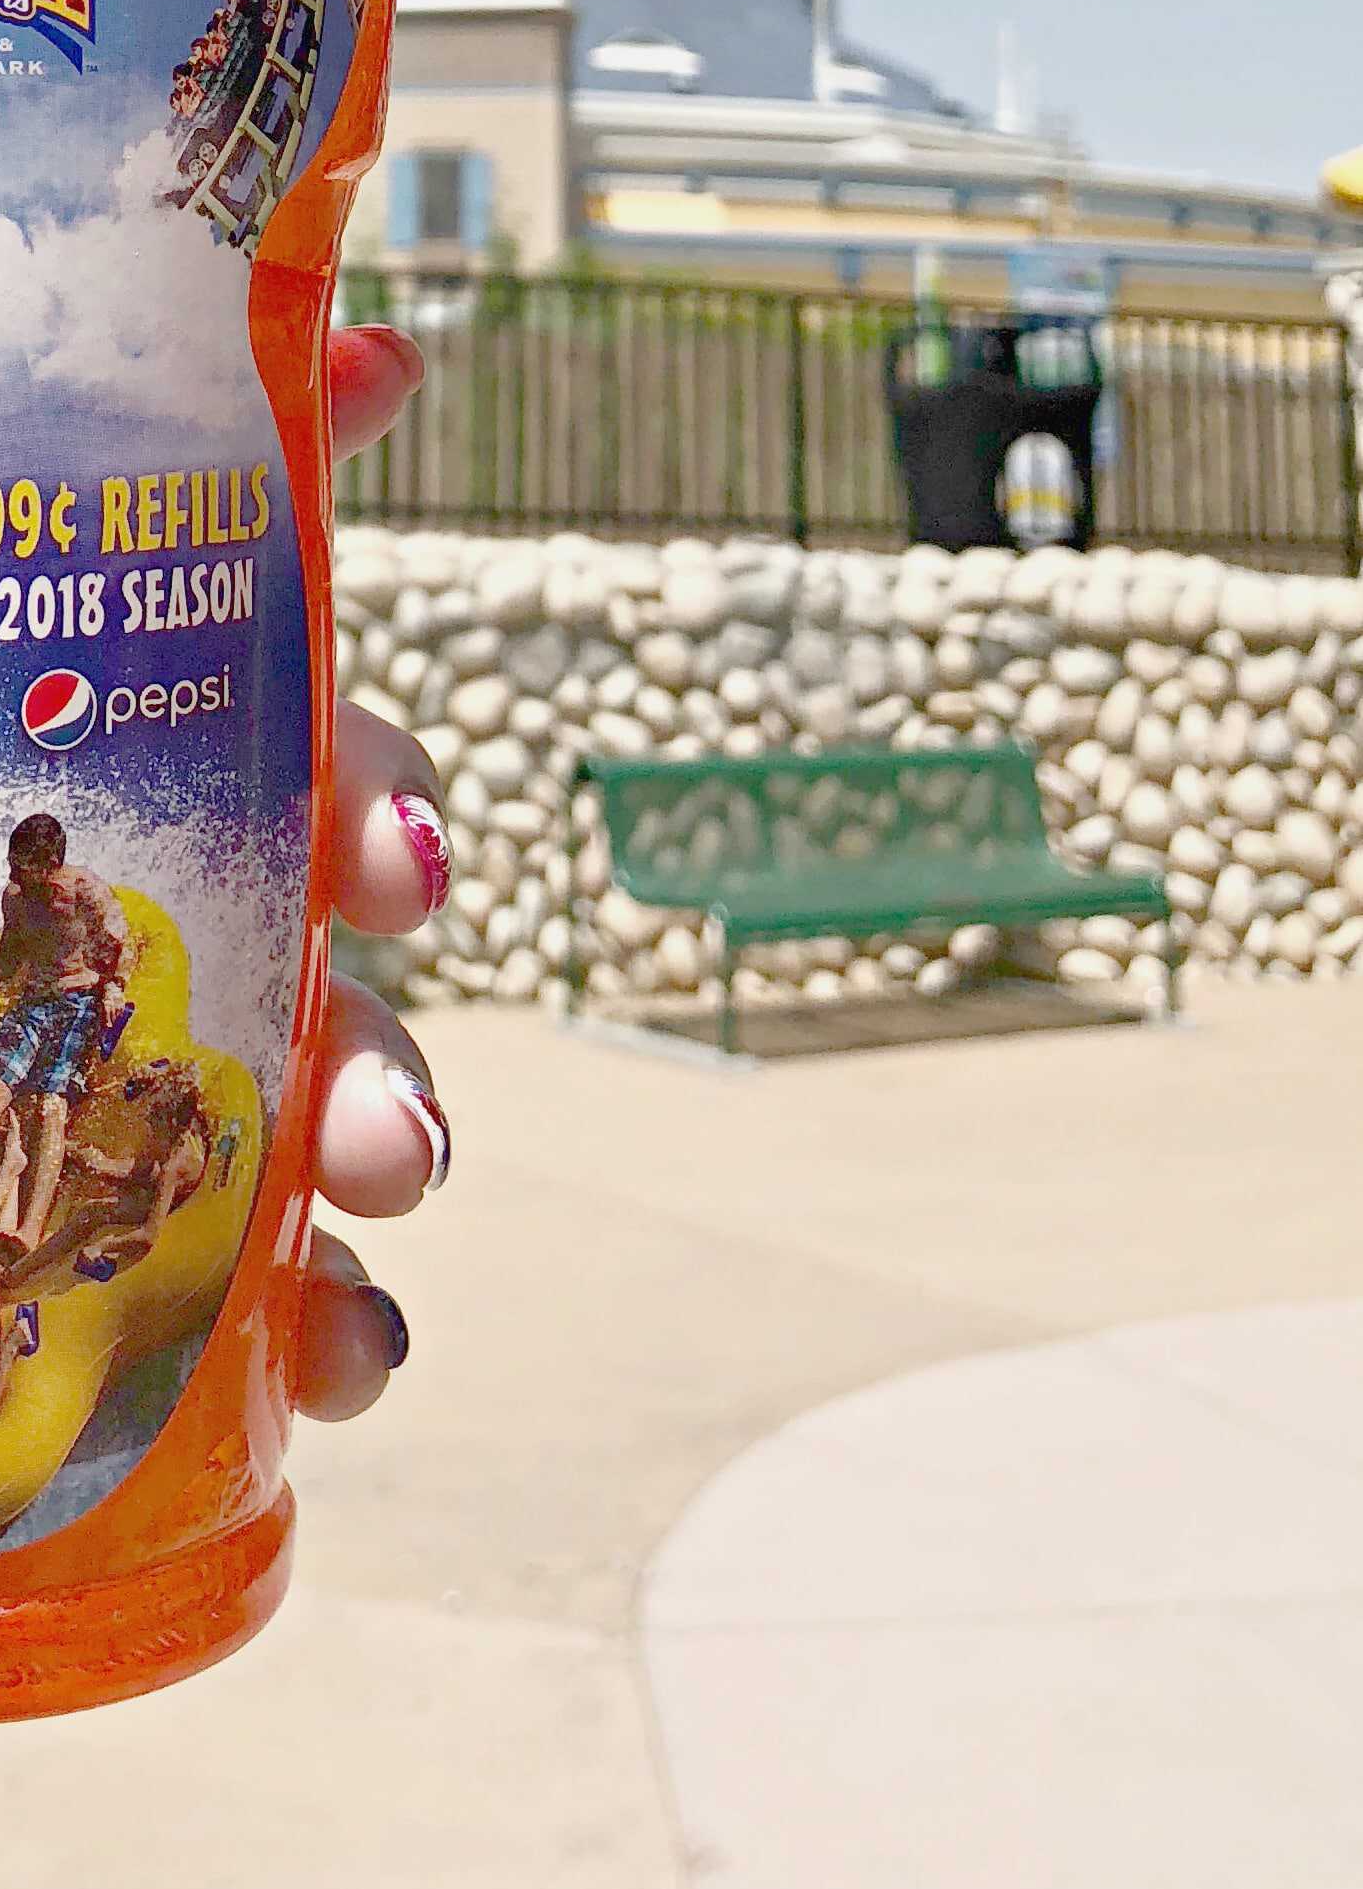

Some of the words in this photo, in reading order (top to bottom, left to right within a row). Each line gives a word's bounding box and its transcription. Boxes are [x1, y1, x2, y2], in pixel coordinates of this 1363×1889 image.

[99, 463, 271, 555] REFILLS
[121, 558, 255, 634] SEASON
[105, 663, 232, 736] pepsi
